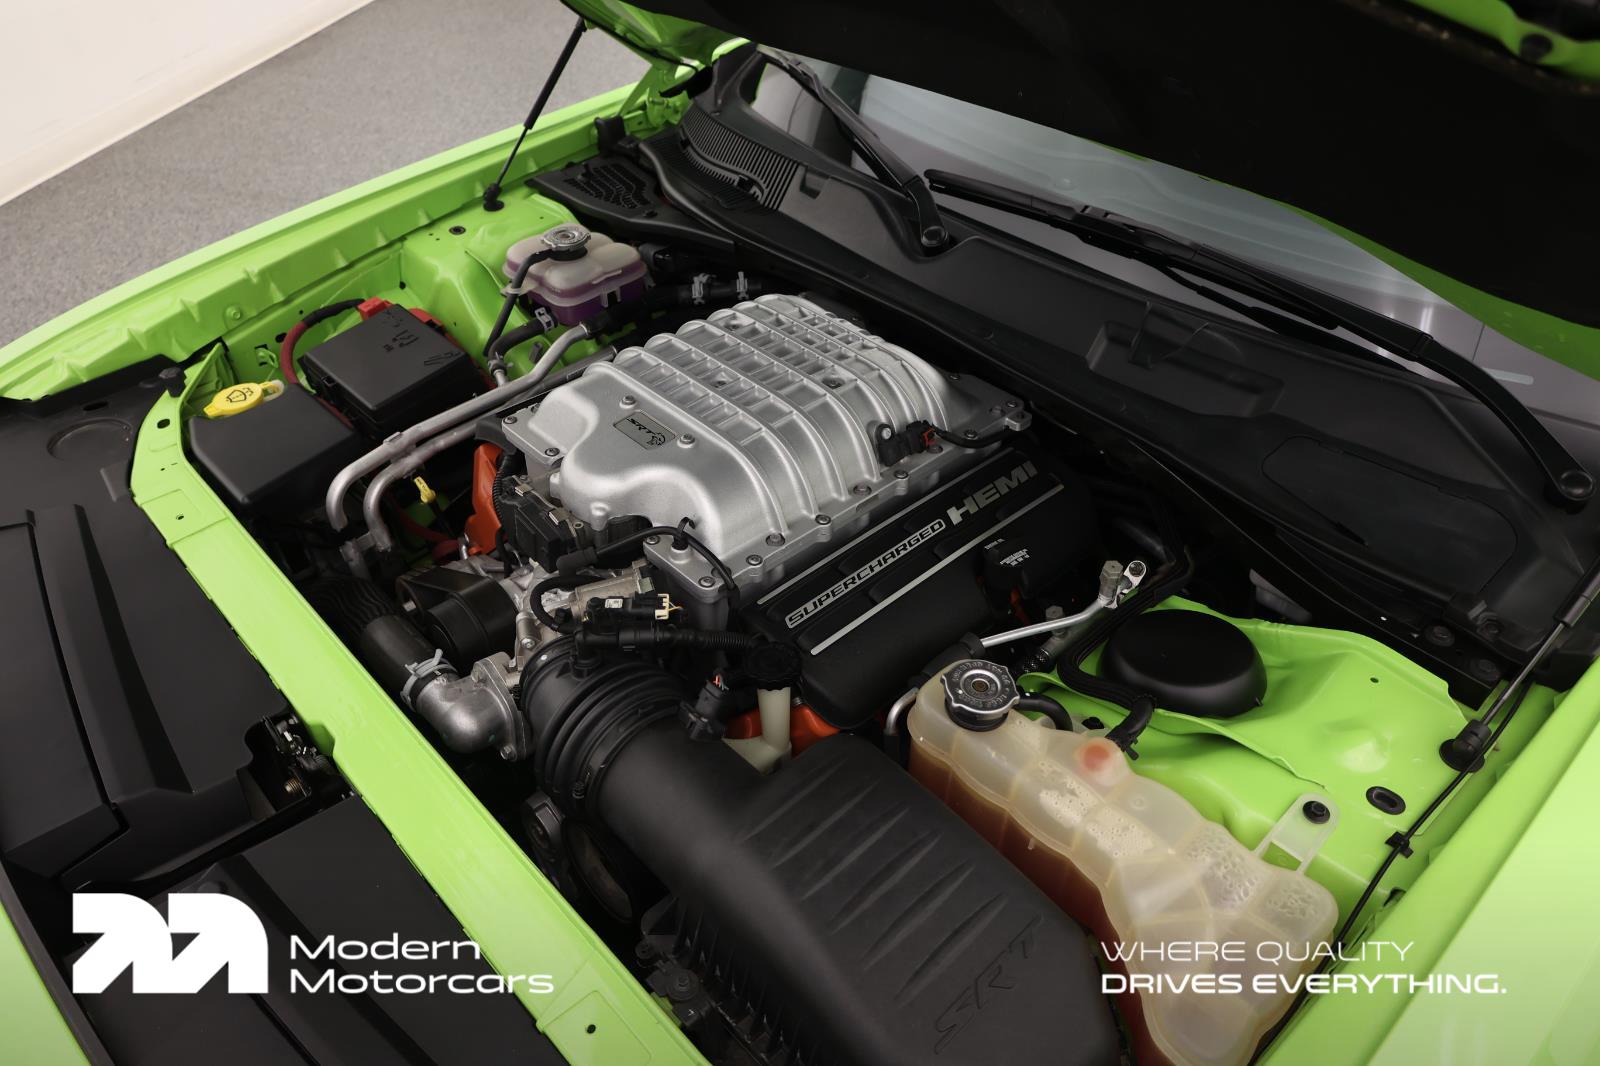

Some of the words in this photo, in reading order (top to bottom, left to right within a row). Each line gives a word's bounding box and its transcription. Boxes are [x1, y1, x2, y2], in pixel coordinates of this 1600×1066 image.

[786, 519, 945, 628] SUPERCHARGED
[946, 460, 1038, 526] HEMI
[934, 911, 1044, 1055] SRT
